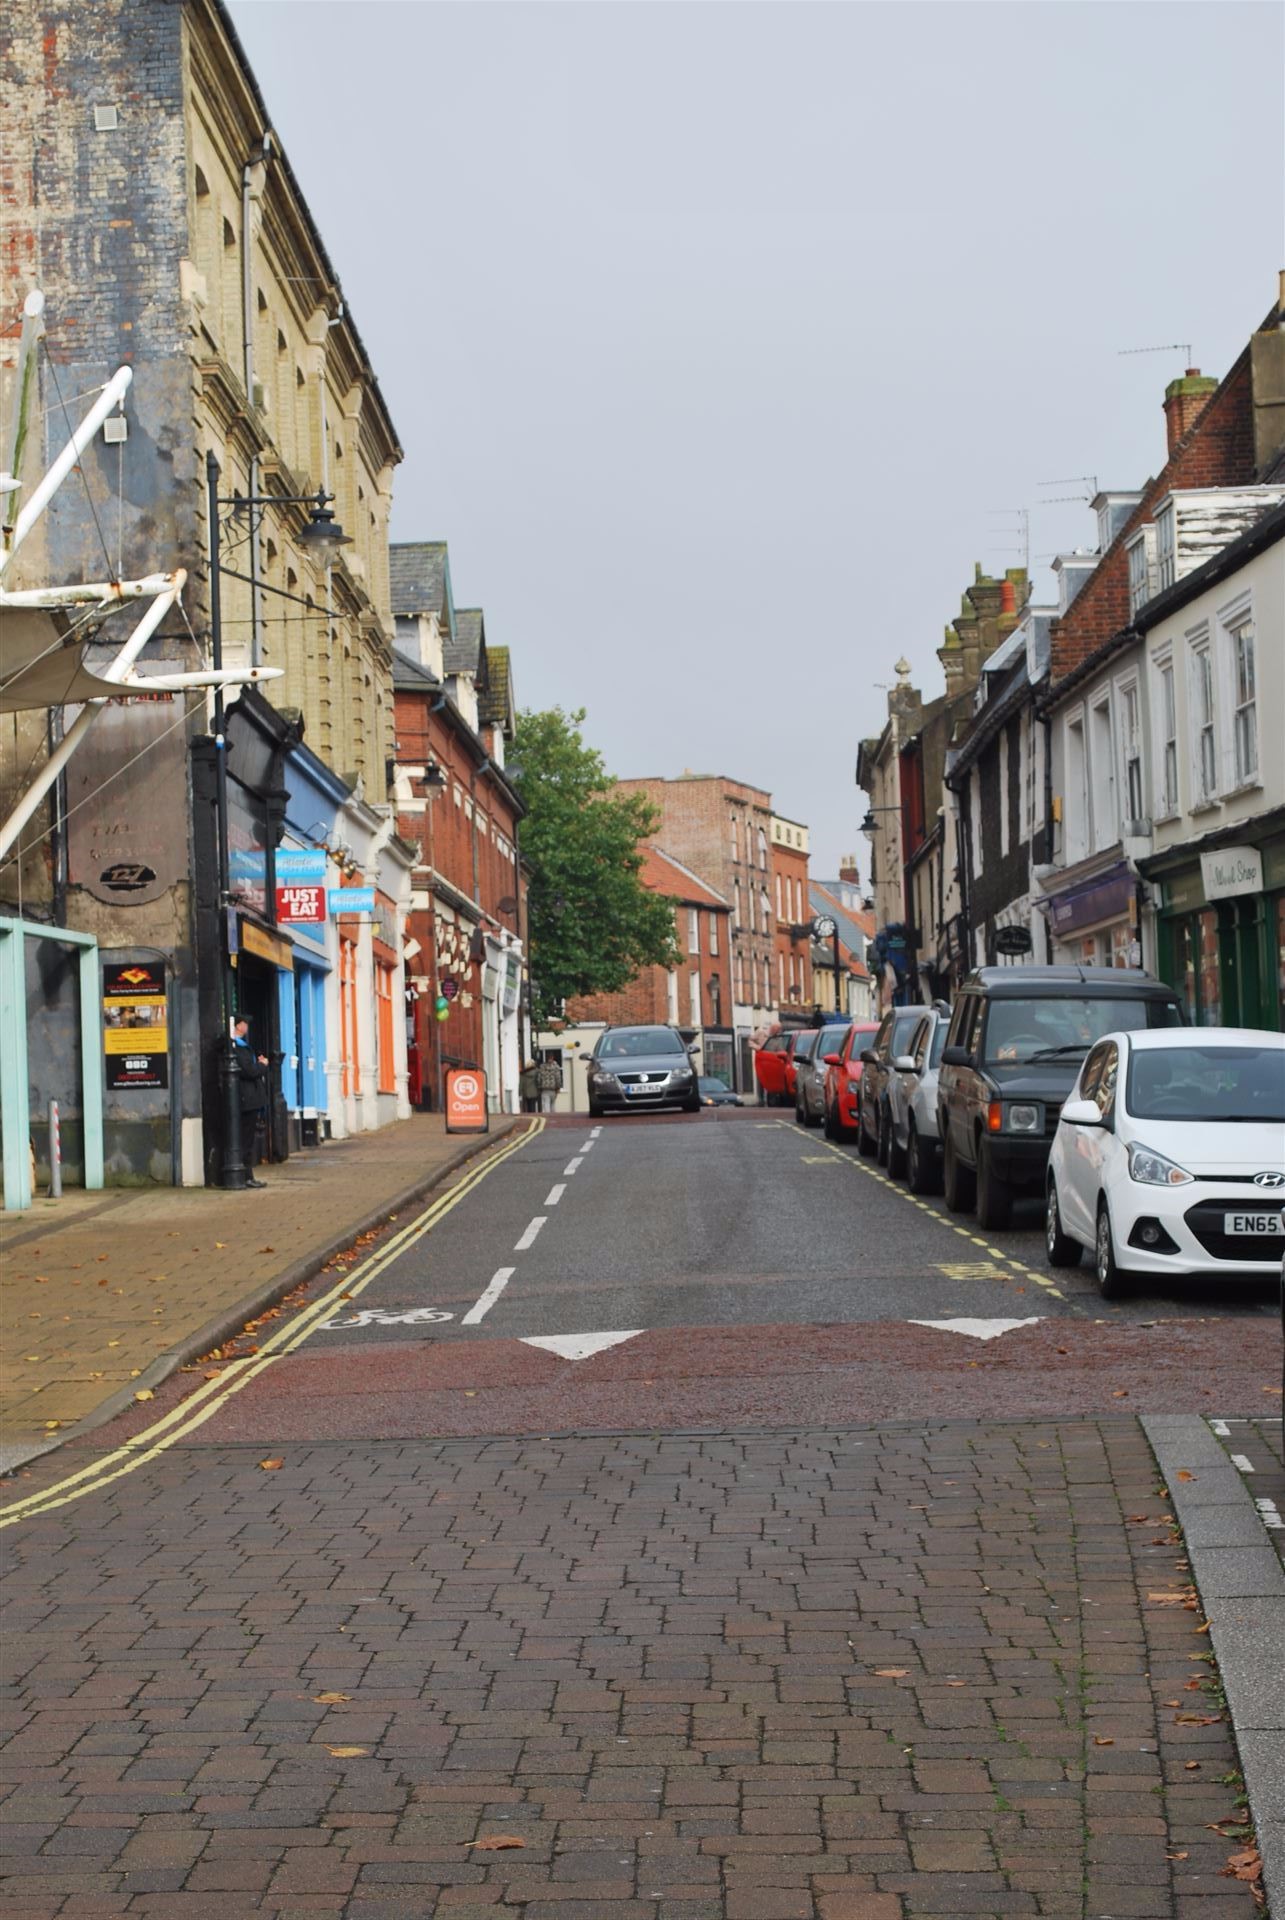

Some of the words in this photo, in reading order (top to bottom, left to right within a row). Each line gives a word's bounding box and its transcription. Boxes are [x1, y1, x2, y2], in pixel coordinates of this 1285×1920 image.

[1237, 860, 1257, 885] Shop
[281, 888, 319, 903] JUST
[290, 902, 319, 916] EAT
[452, 1101, 480, 1113] Open
[1233, 1216, 1277, 1232] EN65
